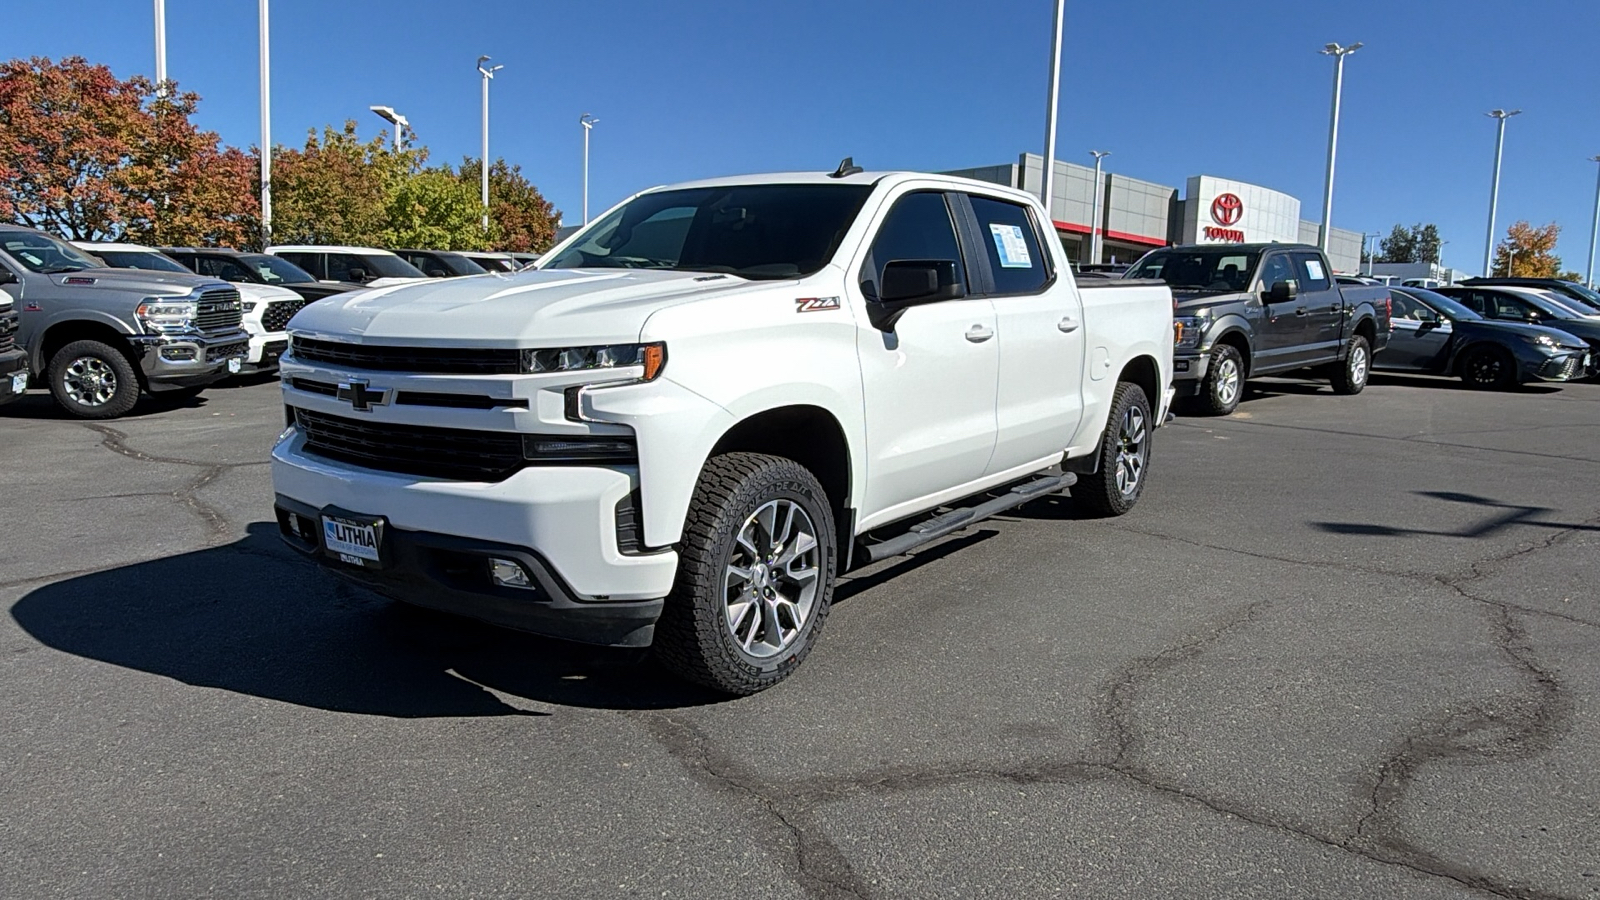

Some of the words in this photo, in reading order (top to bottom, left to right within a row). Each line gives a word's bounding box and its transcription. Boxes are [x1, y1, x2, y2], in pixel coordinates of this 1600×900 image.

[1204, 226, 1245, 243] TOYOTA
[795, 296, 840, 313] Z71
[335, 524, 376, 548] LITHIA
